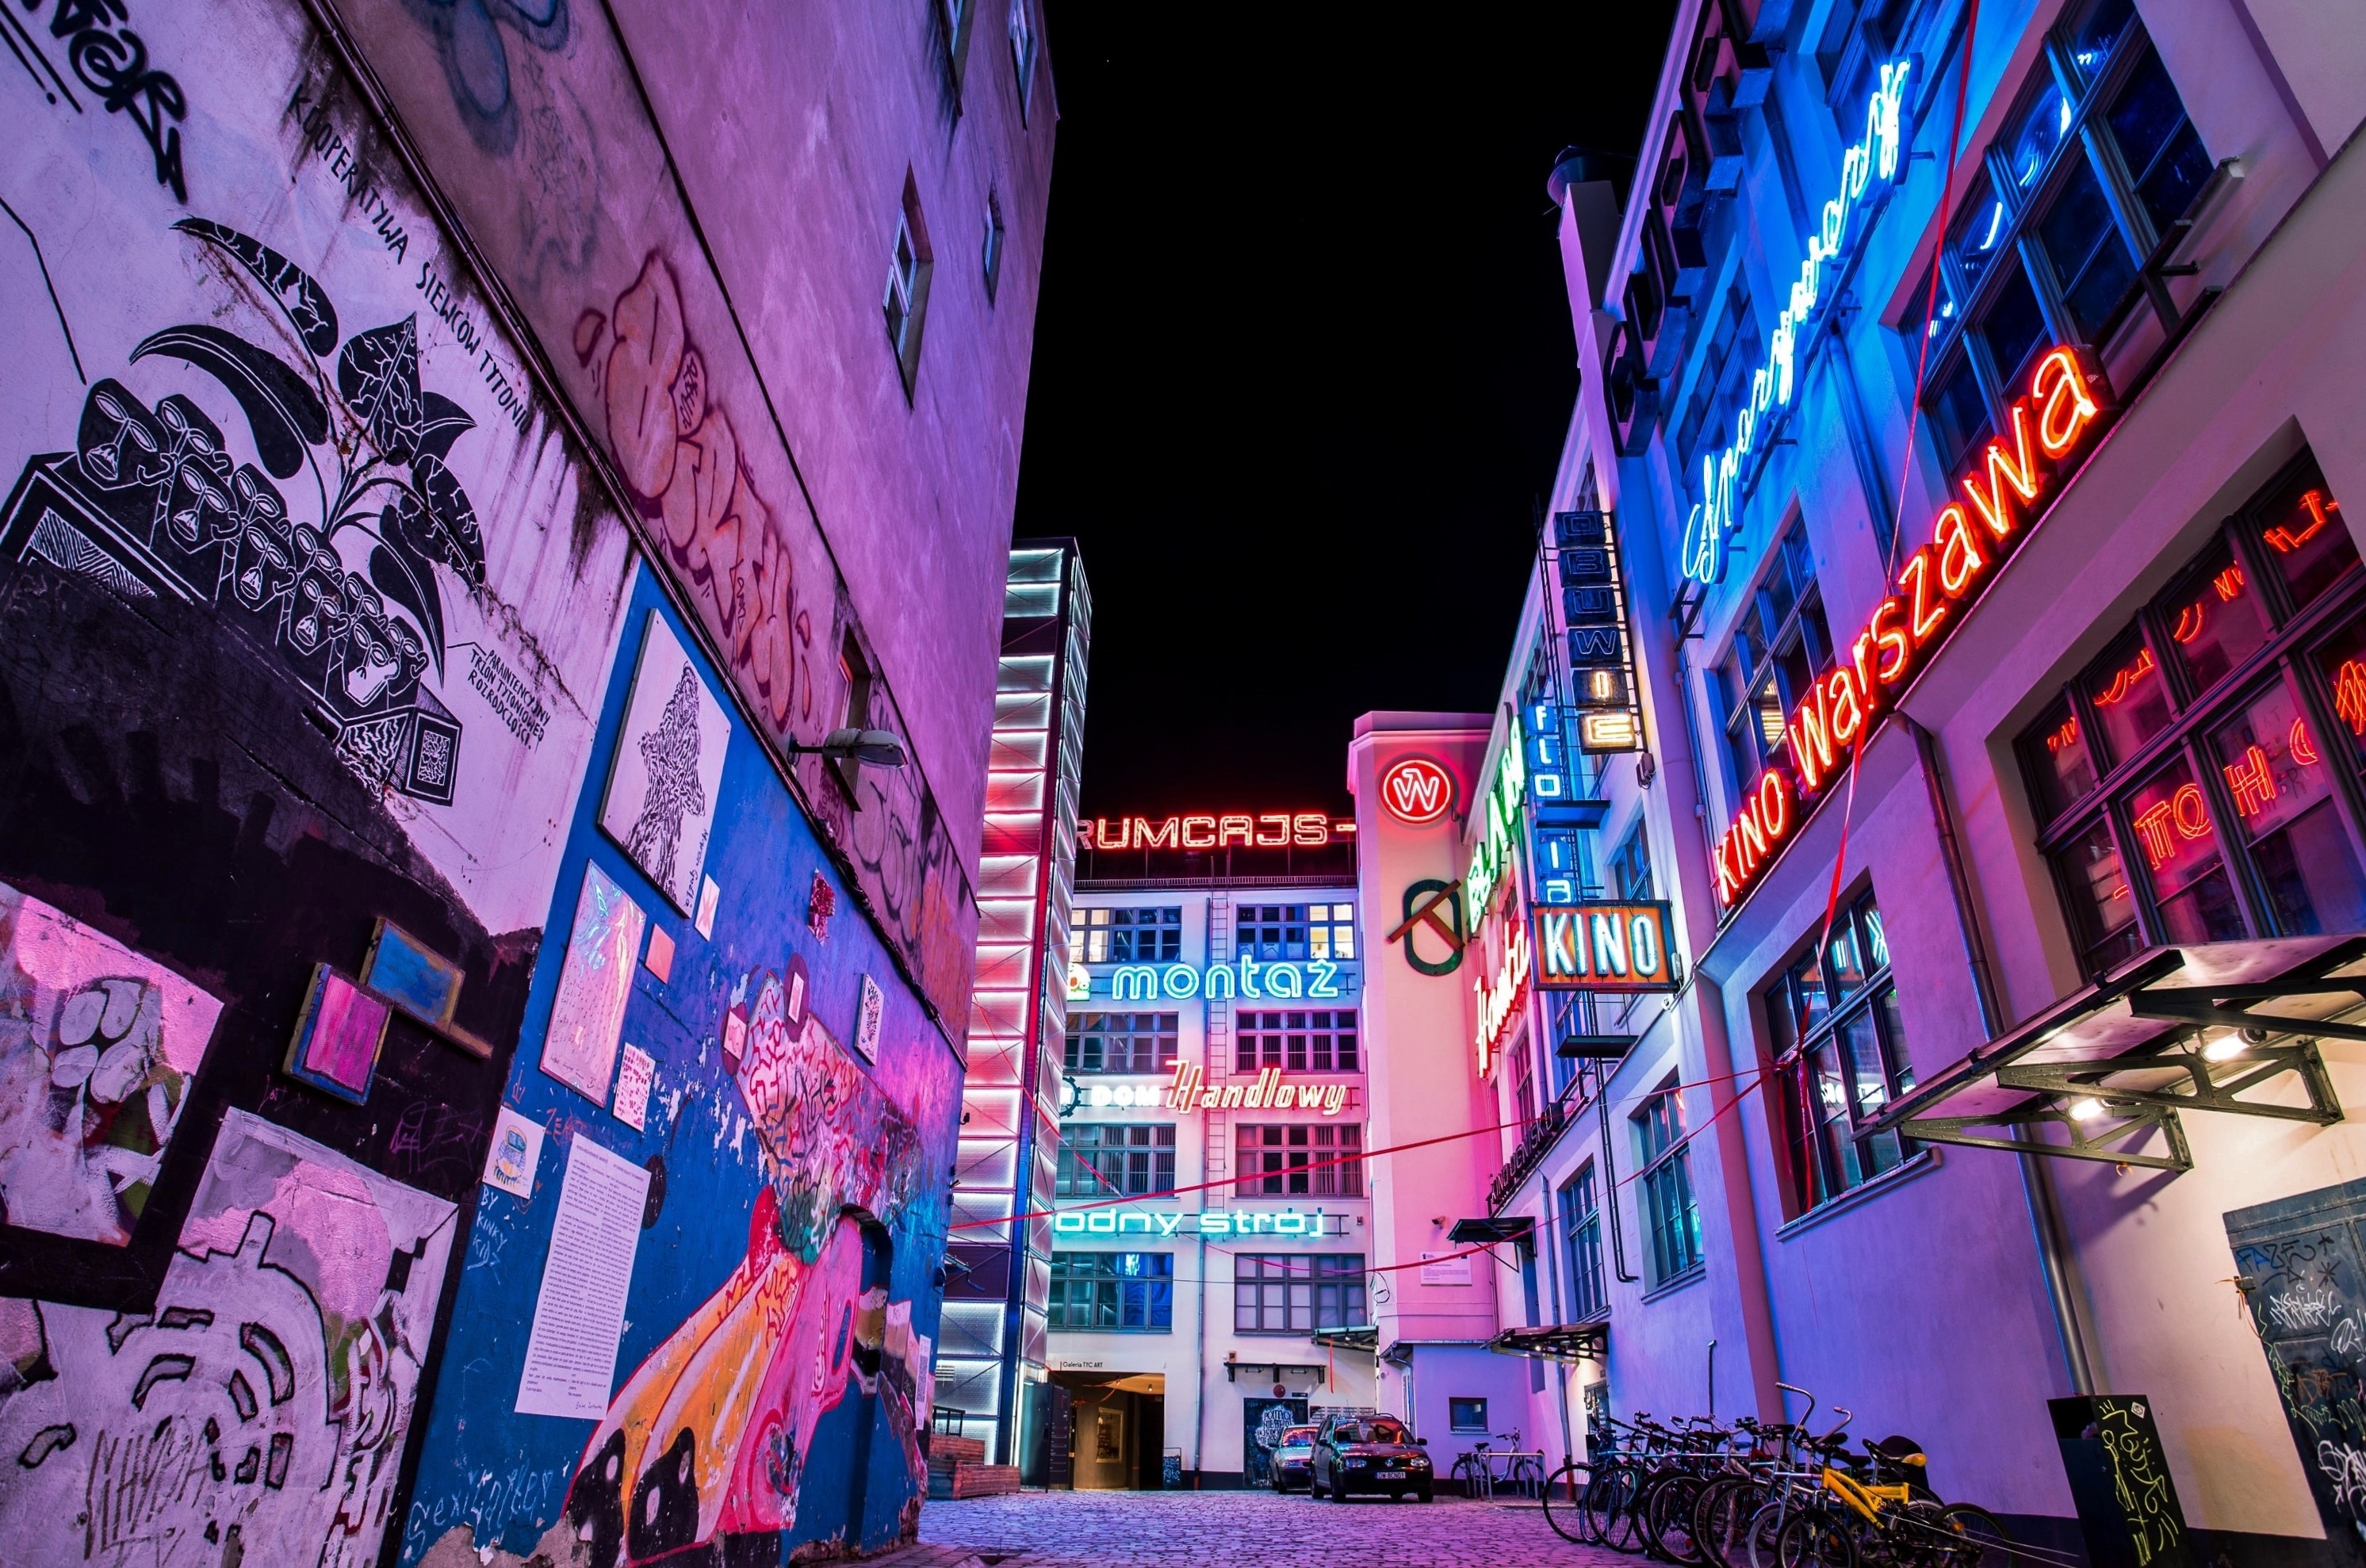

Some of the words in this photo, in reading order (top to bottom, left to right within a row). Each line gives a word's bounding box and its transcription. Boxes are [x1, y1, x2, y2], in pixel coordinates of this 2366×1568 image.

[288, 83, 410, 266] KOOPERATYWA
[415, 262, 481, 357] SIEWCÓW
[479, 349, 530, 436] TYTONIU
[1562, 514, 1635, 744] OBUWIE
[1713, 767, 1785, 904] KINO
[1789, 350, 2097, 788] Warszawa
[1544, 912, 1660, 979] KINO
[1112, 954, 1339, 1001] montaż
[1090, 1084, 1162, 1107] DOM
[1164, 1059, 1347, 1116] Handlowy
[480, 1184, 499, 1210] BY
[477, 1210, 508, 1252] KINKY
